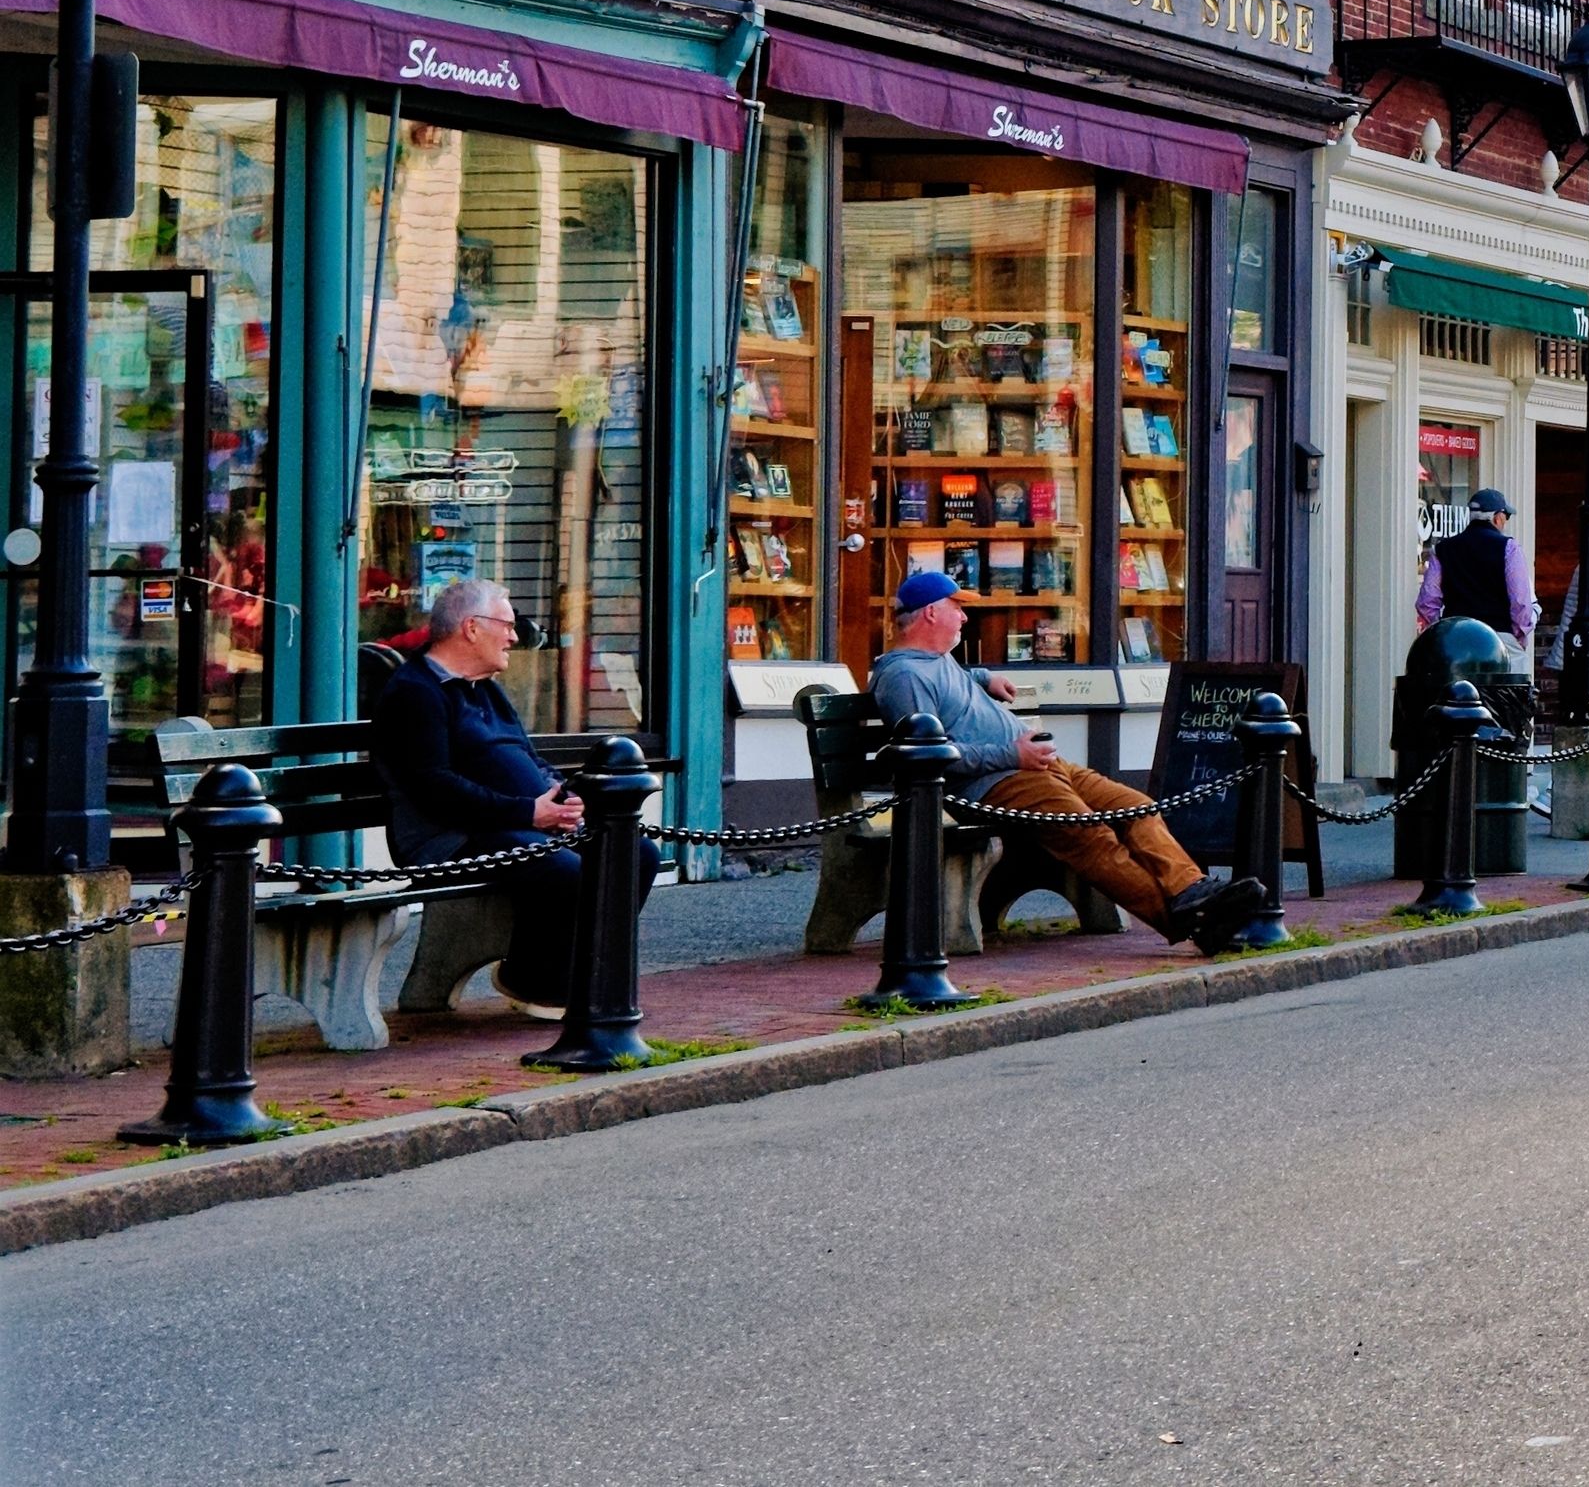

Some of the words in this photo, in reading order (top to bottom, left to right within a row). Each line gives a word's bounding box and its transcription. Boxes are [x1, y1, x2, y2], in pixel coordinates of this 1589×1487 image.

[400, 39, 521, 92] Sherman's
[988, 105, 1065, 151] Sherman's
[1573, 307, 1589, 337] Th
[1180, 710, 1242, 728] SHERMA
[1216, 705, 1228, 713] TO
